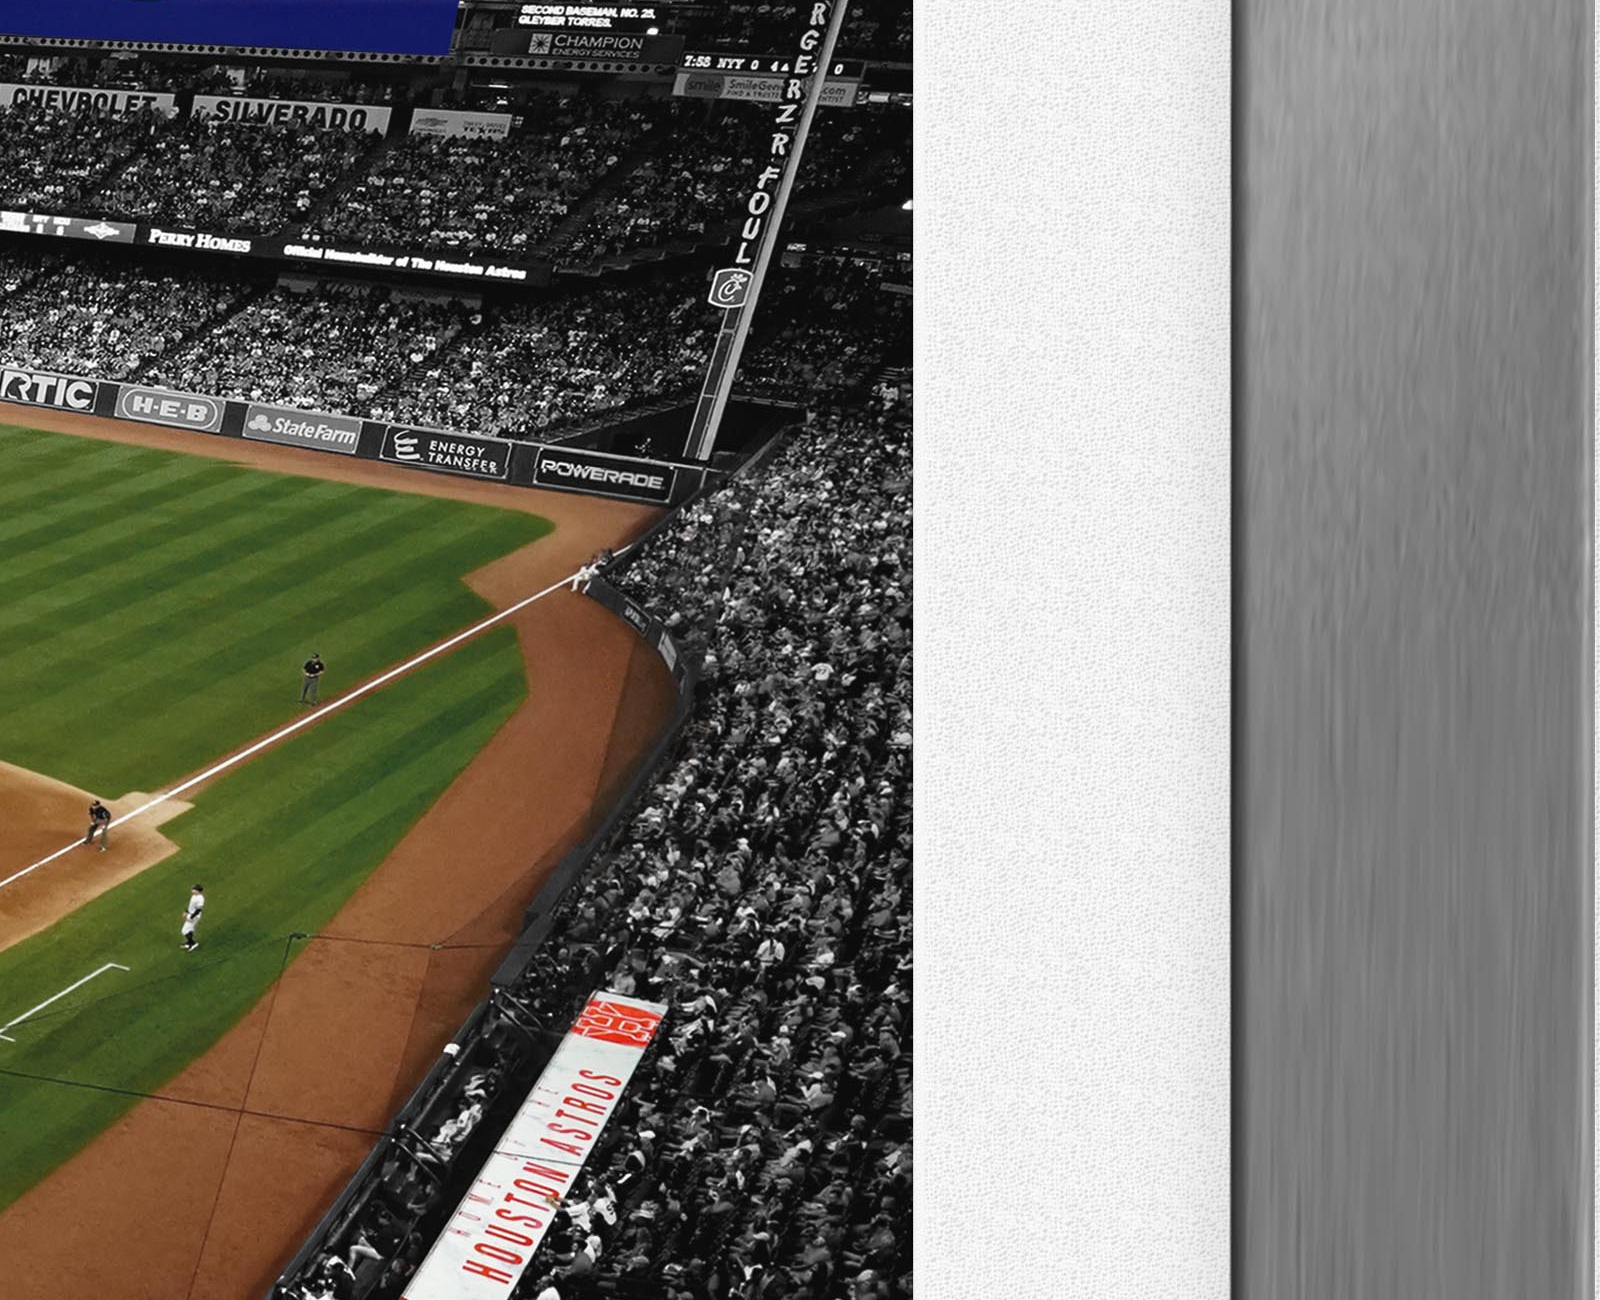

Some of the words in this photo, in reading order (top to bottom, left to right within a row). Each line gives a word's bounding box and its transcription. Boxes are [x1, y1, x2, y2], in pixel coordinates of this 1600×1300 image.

[518, 15, 566, 27] GLEYBER
[521, 5, 564, 16] SECOND
[621, 8, 639, 18] NO.
[552, 48, 586, 57] ENERGY
[588, 49, 639, 59] SERVICES
[554, 34, 644, 50] CHAMPION
[717, 57, 744, 70] NYY
[687, 79, 721, 92] smile
[12, 88, 157, 113] CHEVROLET
[215, 100, 368, 131] SILVERADO
[149, 229, 194, 247] PERRY
[195, 233, 250, 253] HOMES
[284, 244, 323, 259] Official
[411, 257, 432, 271] The
[485, 264, 526, 280] Astros
[4, 370, 93, 408] RTIC
[133, 394, 206, 422] H-E-B
[429, 440, 484, 456] ENERGY
[427, 451, 498, 474] TRANSFER
[541, 459, 664, 488] POWERADE
[462, 1161, 570, 1285] HOUSTON
[540, 1069, 622, 1157] ASTROS
